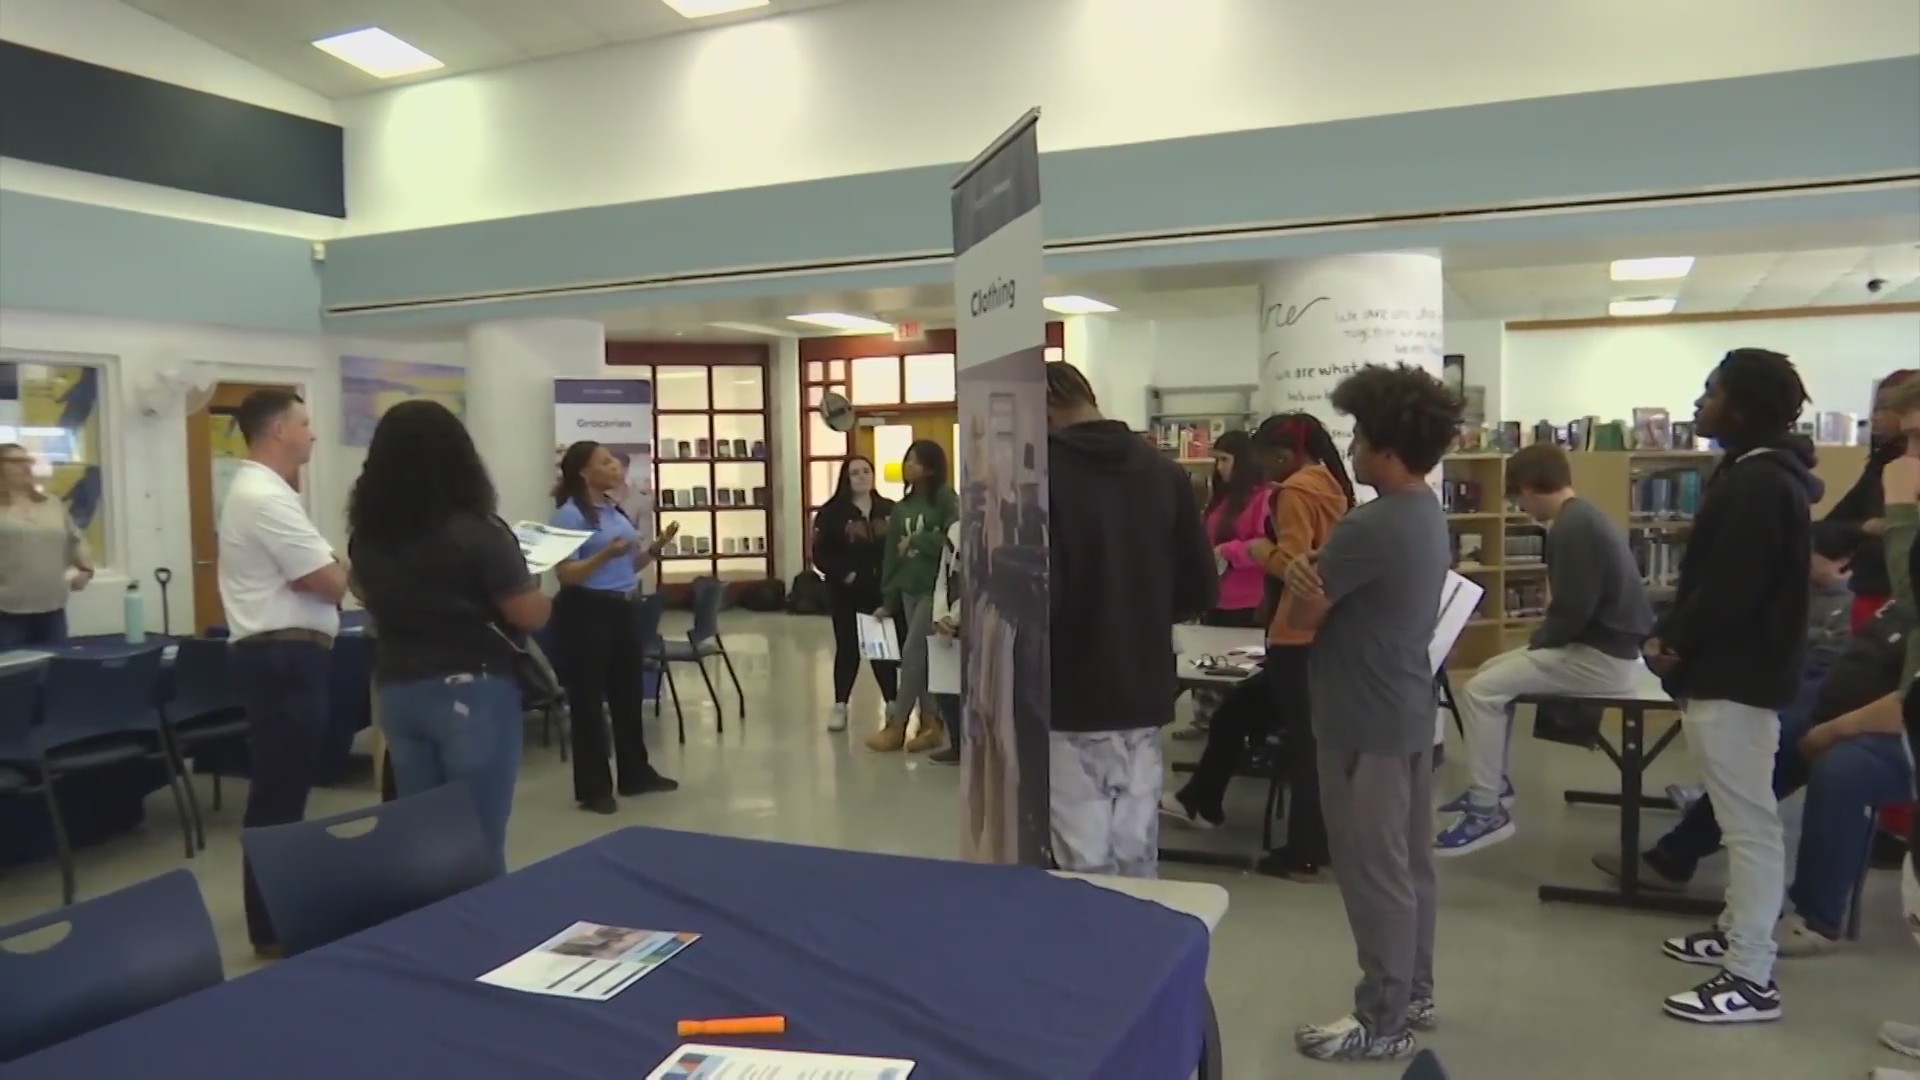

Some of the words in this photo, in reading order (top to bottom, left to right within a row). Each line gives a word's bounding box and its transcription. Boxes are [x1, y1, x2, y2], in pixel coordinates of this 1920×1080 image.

[971, 276, 1016, 317] Clothing
[1296, 367, 1315, 379] are
[1318, 361, 1357, 377] what
[576, 418, 632, 428] Groceries
